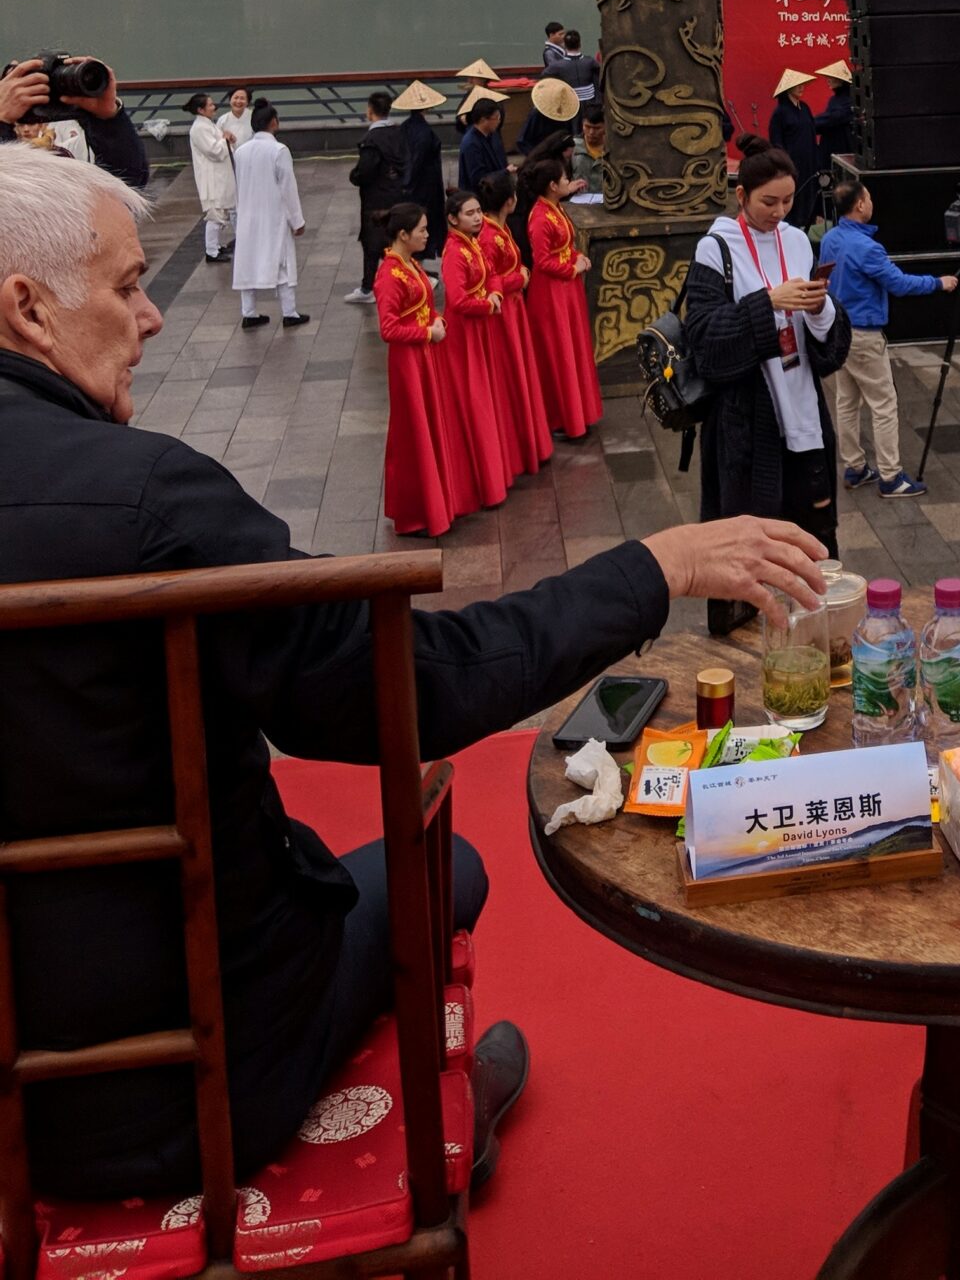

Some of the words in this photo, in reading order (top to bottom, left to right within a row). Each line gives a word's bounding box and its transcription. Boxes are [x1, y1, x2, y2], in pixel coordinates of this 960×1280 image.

[778, 11, 799, 22] The
[801, 11, 820, 22] 3rd
[783, 832, 813, 842] David
[815, 827, 848, 839] Lyons
